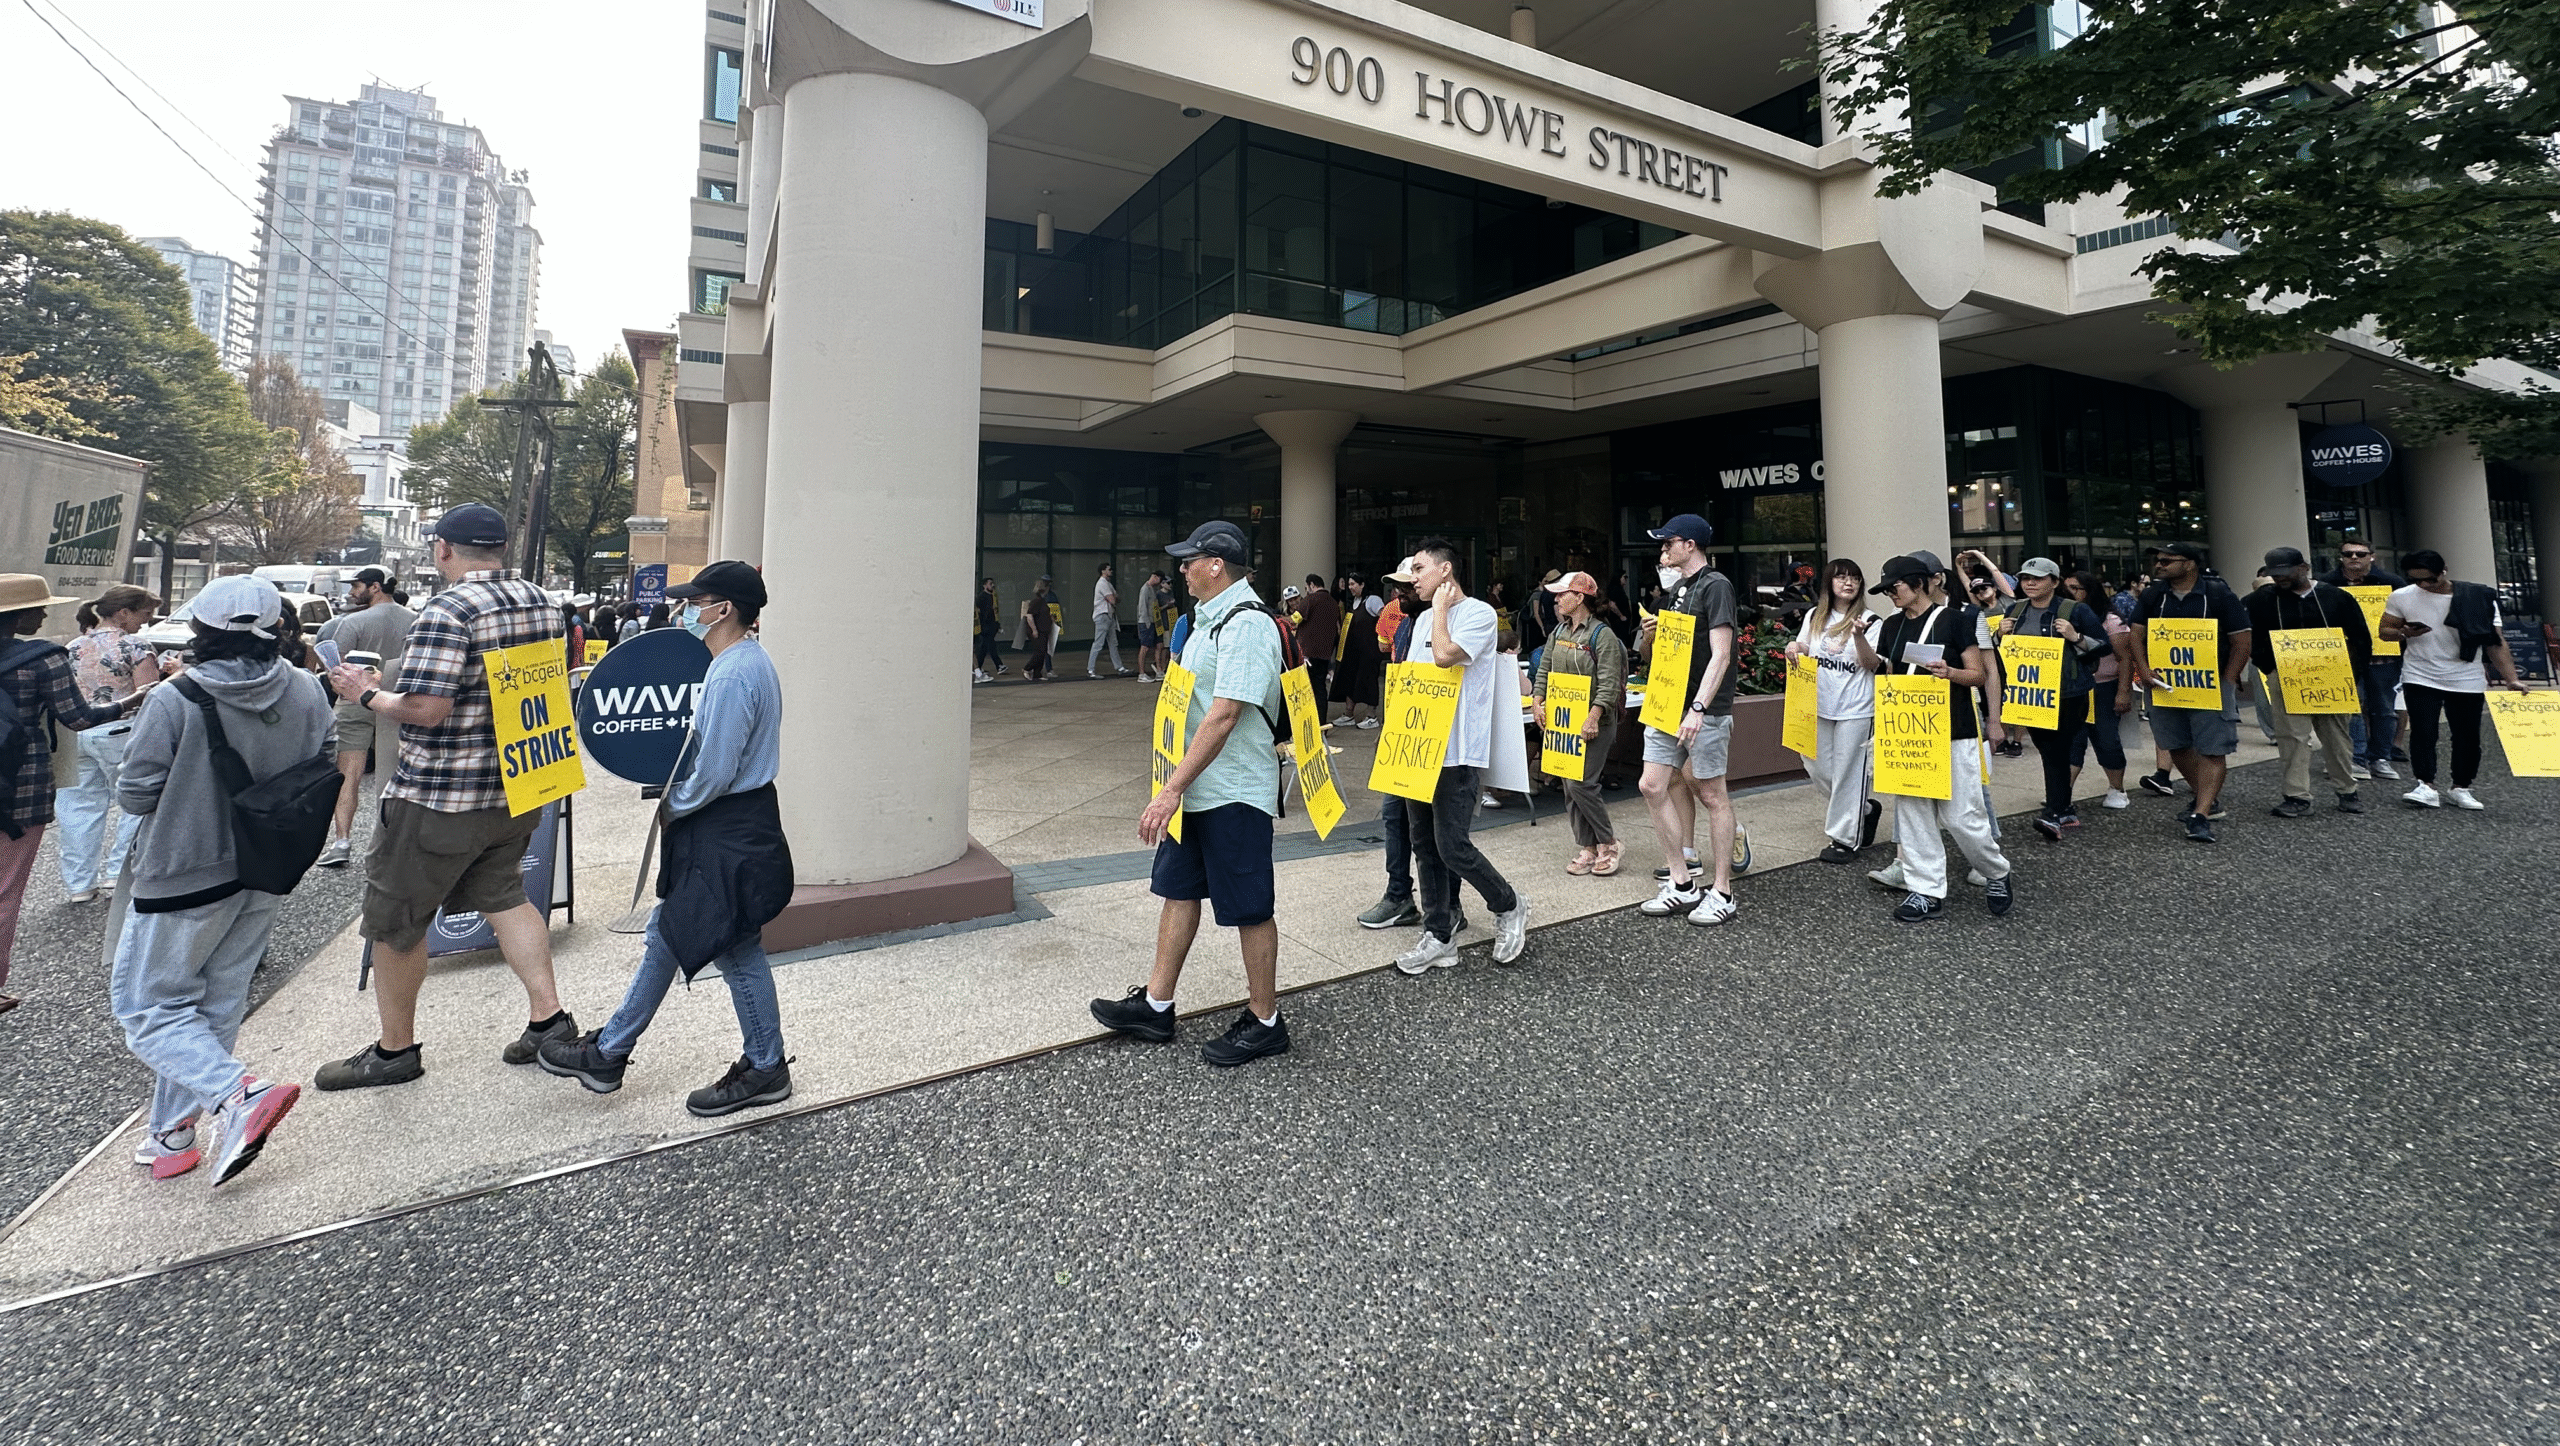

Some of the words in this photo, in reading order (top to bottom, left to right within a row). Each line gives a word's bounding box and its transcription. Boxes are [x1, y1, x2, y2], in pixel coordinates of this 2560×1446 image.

[1291, 36, 1384, 103] 900
[1415, 71, 1566, 157] HOWE
[1589, 126, 1728, 202] STREET
[2311, 444, 2383, 460] WAVES
[2312, 459, 2345, 467] COFFEE
[2352, 456, 2383, 464] HOUSE
[1719, 463, 1800, 489] WAVES
[55, 546, 80, 564] FOOD
[80, 548, 115, 565] SERVICE
[2174, 630, 2214, 642] bcgeu
[2300, 639, 2342, 651] bcgeu
[2023, 647, 2059, 660] bcgeu
[2170, 646, 2195, 666] ON
[522, 663, 564, 685] bcgeu
[1815, 655, 1856, 674] ARNING
[2017, 664, 2040, 684] ON
[1418, 682, 1457, 699] bcgeu
[1558, 689, 1587, 702] bcgeu
[1902, 691, 1945, 707] bcgeu
[520, 693, 549, 731] ON
[1405, 706, 1429, 731] ON
[1555, 706, 1571, 729] ON
[592, 717, 664, 735] COFFEE
[1883, 711, 1940, 735] HONK
[1163, 716, 1175, 756] ON
[1303, 715, 1315, 754] ON
[1544, 729, 1583, 757] STRIKE
[1878, 739, 1891, 747] TO
[1895, 739, 1933, 749] SUPPORT
[503, 725, 576, 778] STRIKE
[1378, 731, 1442, 770] STRIKE!
[1883, 750, 1897, 758] BC
[1900, 750, 1931, 758] PUBLIC
[1300, 747, 1329, 802] STRIKE
